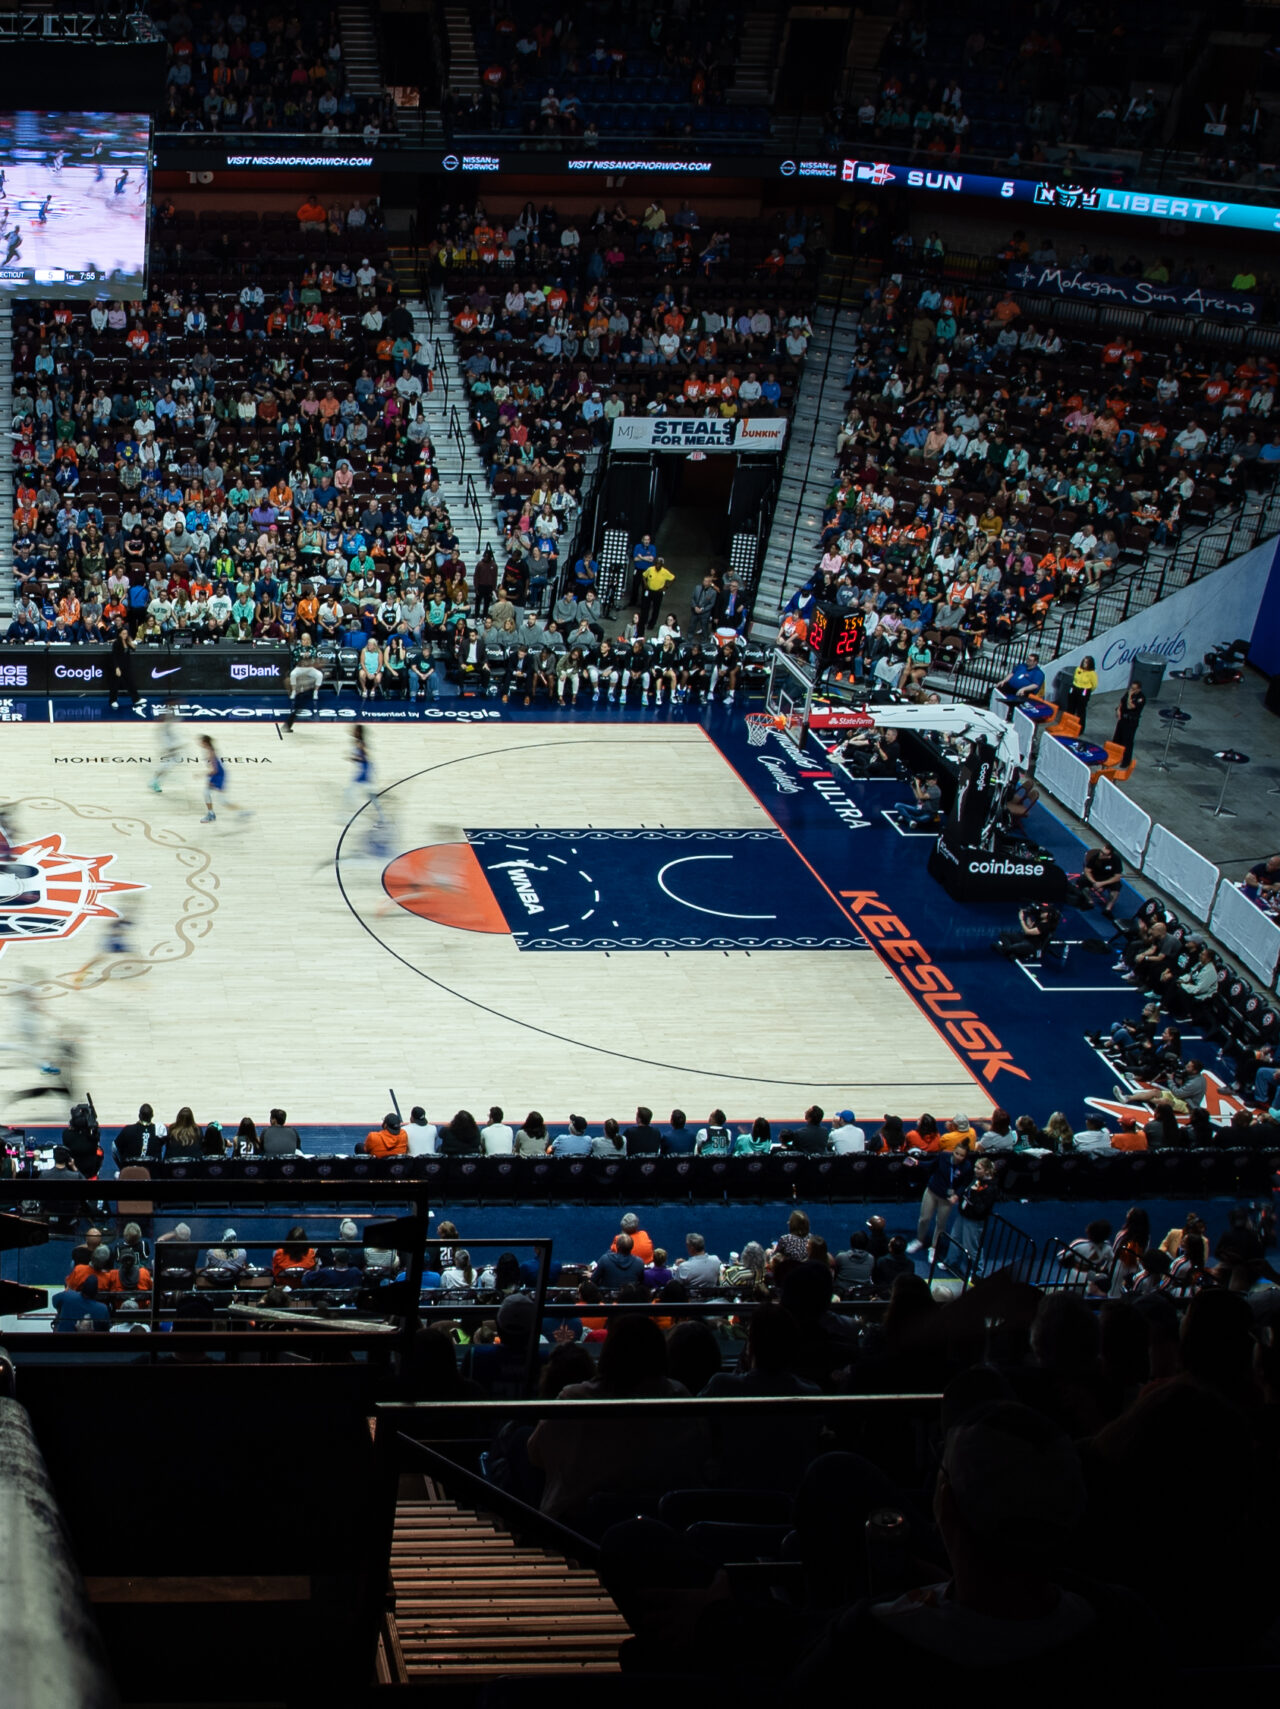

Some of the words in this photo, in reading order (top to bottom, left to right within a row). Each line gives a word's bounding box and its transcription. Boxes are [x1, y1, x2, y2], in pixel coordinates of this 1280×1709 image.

[227, 156, 251, 165] VISIT
[252, 156, 373, 167] NISSANOFNORWICH.COM
[462, 163, 499, 171] NORWICH
[568, 160, 591, 170] VISIT
[593, 160, 712, 171] NISSANOFNORWICH.COM
[799, 168, 836, 176] NORWICH
[908, 171, 963, 192] SUN
[1001, 182, 1014, 198] 5
[1106, 193, 1228, 222] LIBERTY
[80, 272, 95, 280] 7:55
[1037, 268, 1127, 300] Mohegan
[1132, 283, 1177, 303] Sun
[1182, 288, 1256, 315] Arena
[653, 421, 732, 435] STEALS
[651, 436, 681, 446] FOR
[684, 436, 735, 446] MEALS
[844, 616, 863, 631] 7:54
[810, 623, 824, 650] 22
[836, 630, 858, 655] 22
[317, 651, 336, 659] Google
[1101, 631, 1187, 671] Courtside
[54, 664, 103, 681] Google
[361, 710, 410, 718] Presented
[411, 710, 420, 719] by
[424, 708, 501, 720] Google
[976, 762, 989, 791] Google
[813, 780, 872, 829] ULTRA
[969, 860, 1044, 876] coinbase
[507, 868, 544, 915] WNBA
[838, 890, 1031, 1082] KEESUSK
